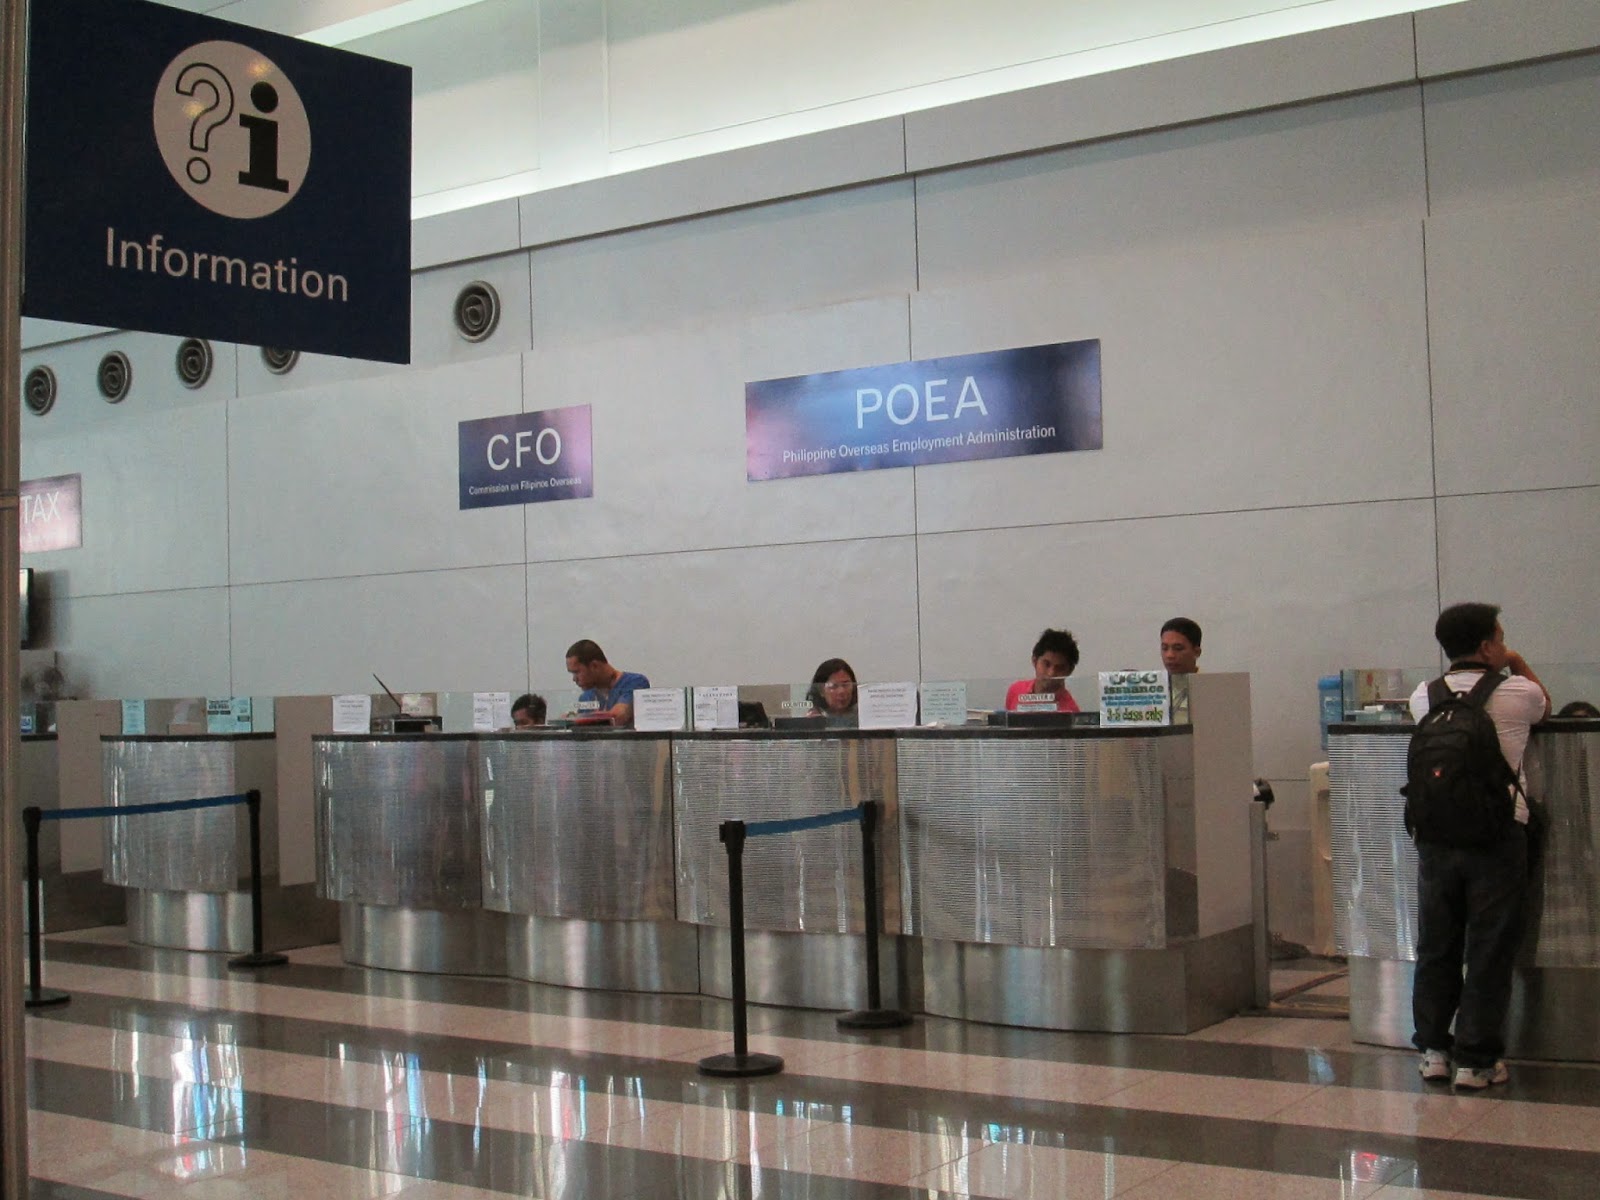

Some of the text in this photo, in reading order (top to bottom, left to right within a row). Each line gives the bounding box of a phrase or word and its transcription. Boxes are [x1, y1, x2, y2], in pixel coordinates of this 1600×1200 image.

[106, 226, 349, 302] Information
[855, 375, 989, 430] POEA
[486, 427, 562, 471] CFO
[782, 424, 1056, 464] Philippine Overseas Employment Administration
[20, 490, 62, 525] TAX
[468, 483, 509, 496] Commission
[549, 477, 582, 487] Overseas
